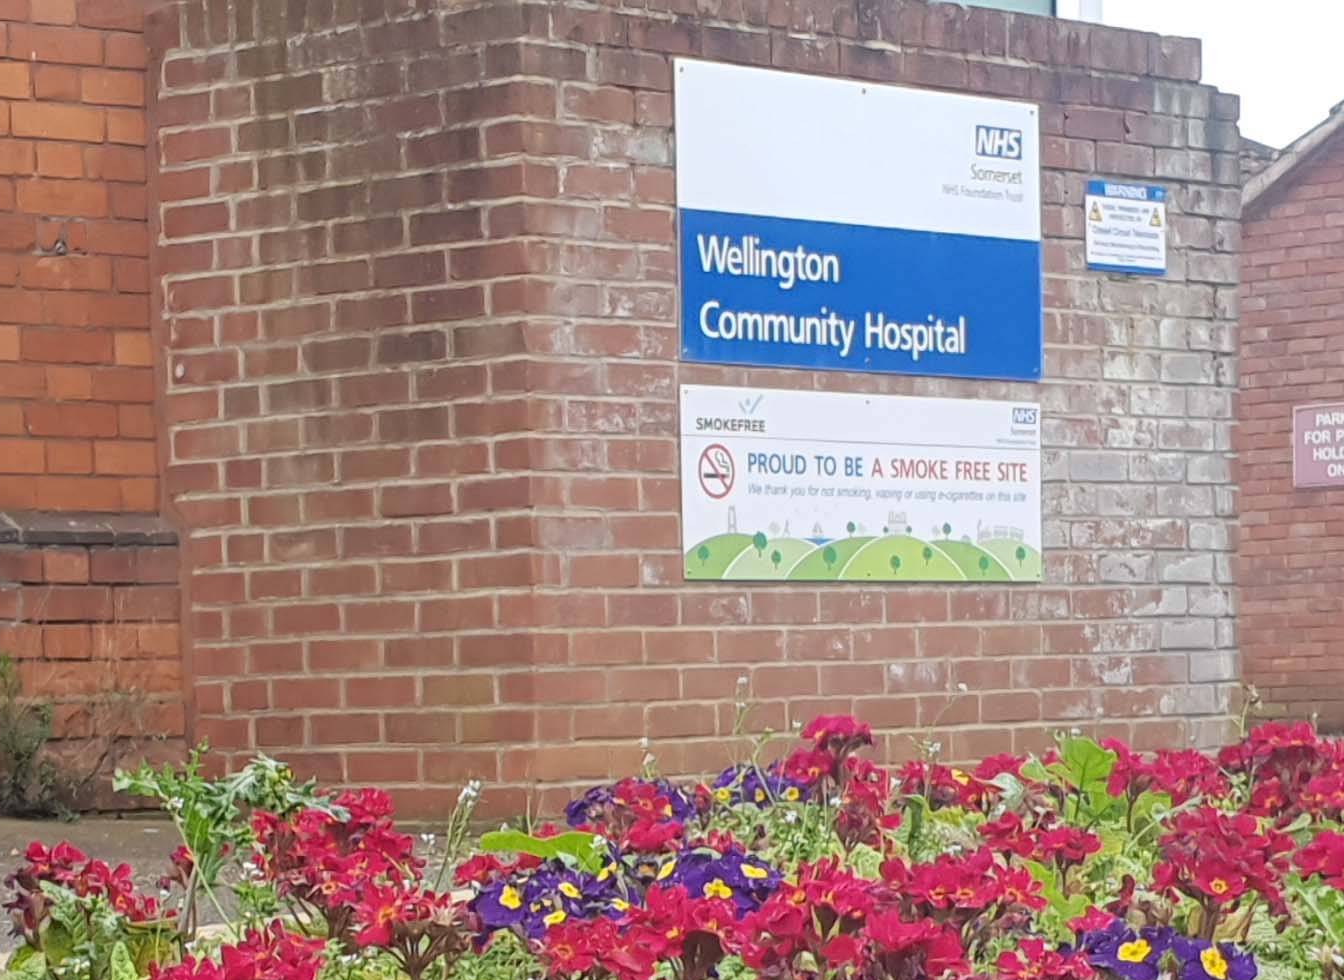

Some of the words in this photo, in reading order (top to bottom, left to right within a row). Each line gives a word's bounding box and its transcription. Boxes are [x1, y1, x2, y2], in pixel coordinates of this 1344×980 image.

[976, 126, 1022, 160] NHS
[970, 162, 1022, 184] Somerset
[697, 234, 840, 290] Wellington
[699, 301, 855, 357] Community
[864, 311, 966, 361] Hospital
[696, 417, 766, 433] SMOKEFREE
[1012, 407, 1037, 424] NHS
[1304, 430, 1331, 445] FOR
[747, 452, 806, 475] PROUD
[815, 455, 837, 477] TO
[844, 457, 864, 477] BE
[871, 458, 884, 478] A
[890, 458, 948, 481] SMOKE
[956, 460, 991, 482] FREE
[997, 463, 1028, 483] SITE
[748, 482, 762, 495] We
[765, 483, 786, 496] thank
[790, 486, 805, 499] you
[807, 484, 820, 497] for
[821, 486, 835, 497] not
